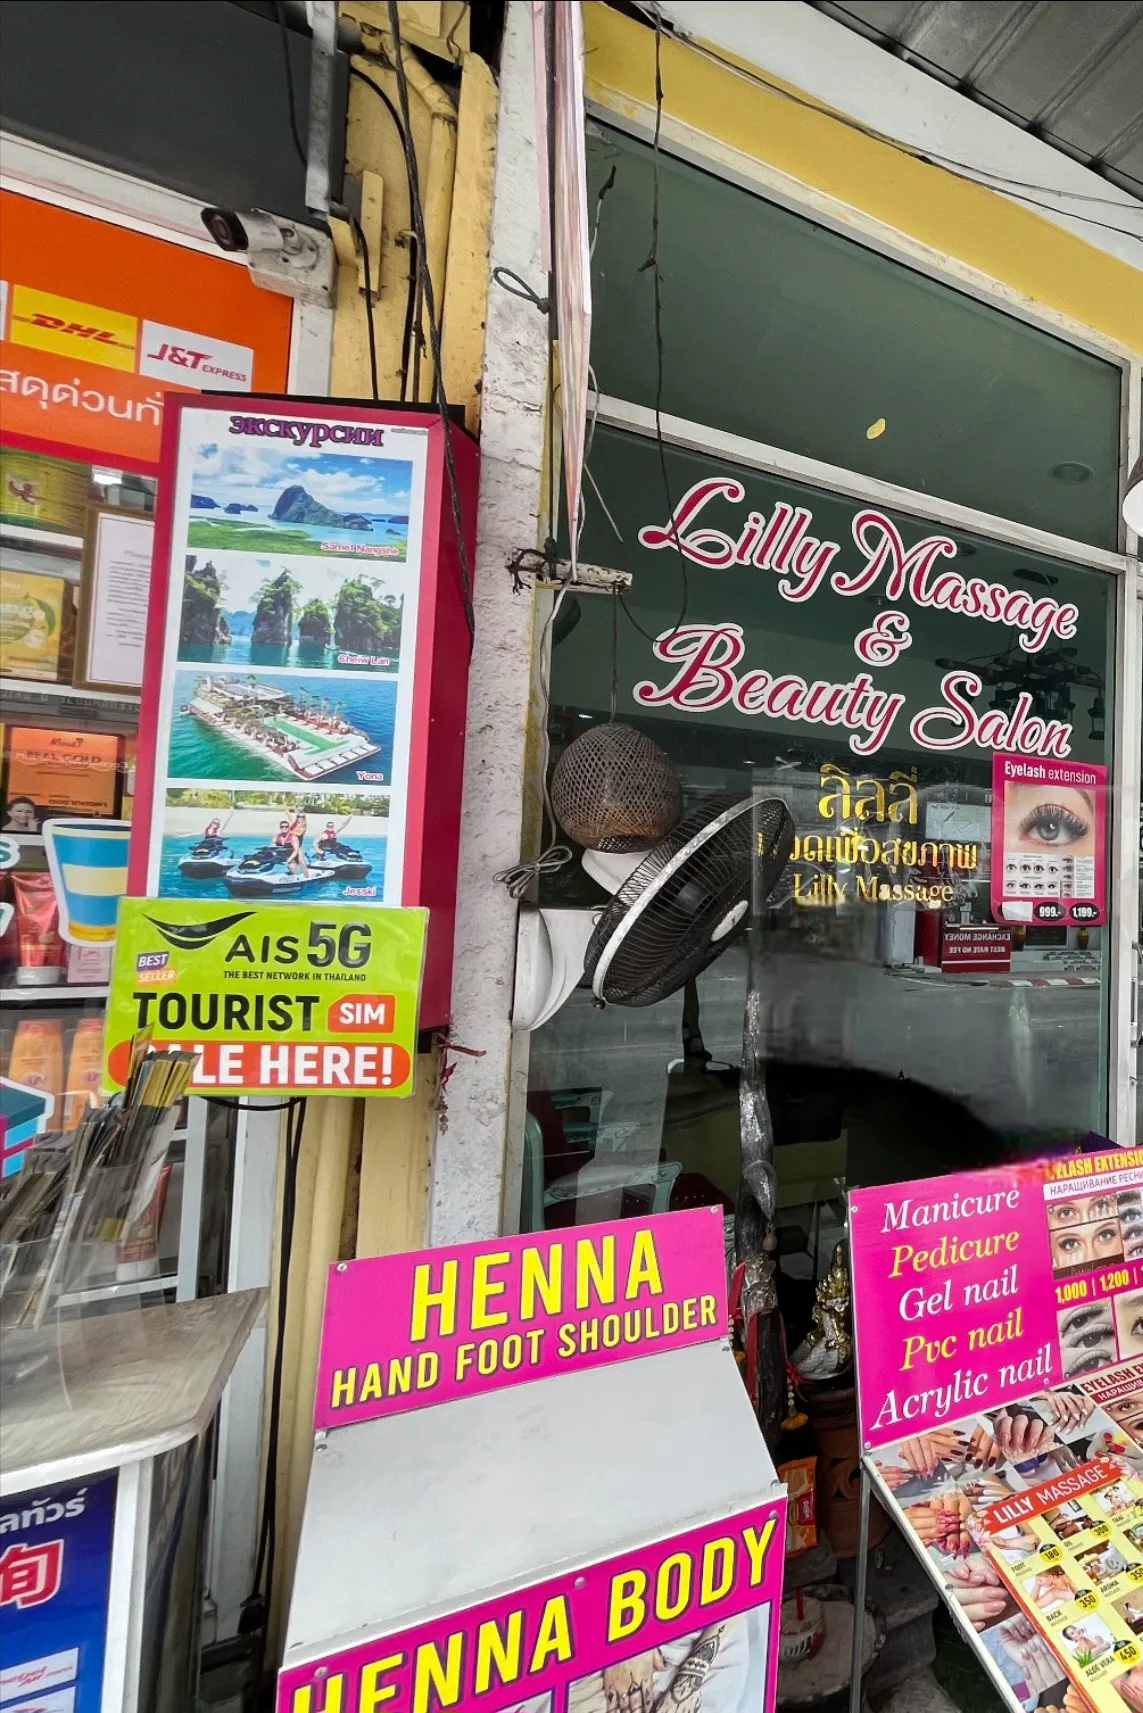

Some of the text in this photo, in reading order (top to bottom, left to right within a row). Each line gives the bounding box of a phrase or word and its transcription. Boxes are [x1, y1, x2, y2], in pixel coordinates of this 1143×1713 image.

[31, 313, 119, 345] DHL
[148, 344, 247, 382] J&T EXPRESS
[638, 477, 1078, 653] Lilly Massage
[854, 610, 912, 667] &
[632, 623, 1073, 758] Beauty Salon
[1004, 761, 1097, 785] Eyelash extension
[757, 827, 978, 874] ดเพื่อสุขภาพ
[793, 873, 954, 910] Lilly Massage
[1039, 906, 1062, 919] 999.-
[138, 952, 168, 968] BEST
[225, 921, 372, 968] AIS 5G
[138, 968, 176, 982] SELLER
[223, 971, 366, 982] THE BEST NETWORK IN THAILAND
[132, 991, 386, 1031] TOURIST SIM
[147, 1044, 394, 1086] LE HERE!
[1050, 1176, 1118, 1196] НАРАЩИВАНИЕ
[1051, 1157, 1092, 1179] ELASH
[881, 1187, 1020, 1234] Manicure
[888, 1231, 1020, 1278] Pedicure
[410, 1228, 663, 1343] HENNA
[899, 1280, 953, 1322] Gel
[964, 1263, 1019, 1305] nail
[1055, 1279, 1088, 1304] 1,000
[1099, 1268, 1130, 1293] 1,200
[331, 1293, 718, 1409] HAND FOOT SHOULDER
[899, 1306, 1024, 1373] Pvc nail
[869, 1342, 1053, 1432] Acrylic nail
[1080, 1366, 1134, 1394] EYELASH
[993, 1463, 1109, 1525] LILLY MASSAGE
[1093, 1525, 1109, 1537] 300
[607, 1519, 776, 1643] BODY
[1099, 1579, 1119, 1594] AROMA
[1045, 1610, 1063, 1623] BACK
[1079, 1594, 1097, 1609] 350
[1085, 1655, 1116, 1679] ALOE VERA
[1119, 1645, 1137, 1661] 450
